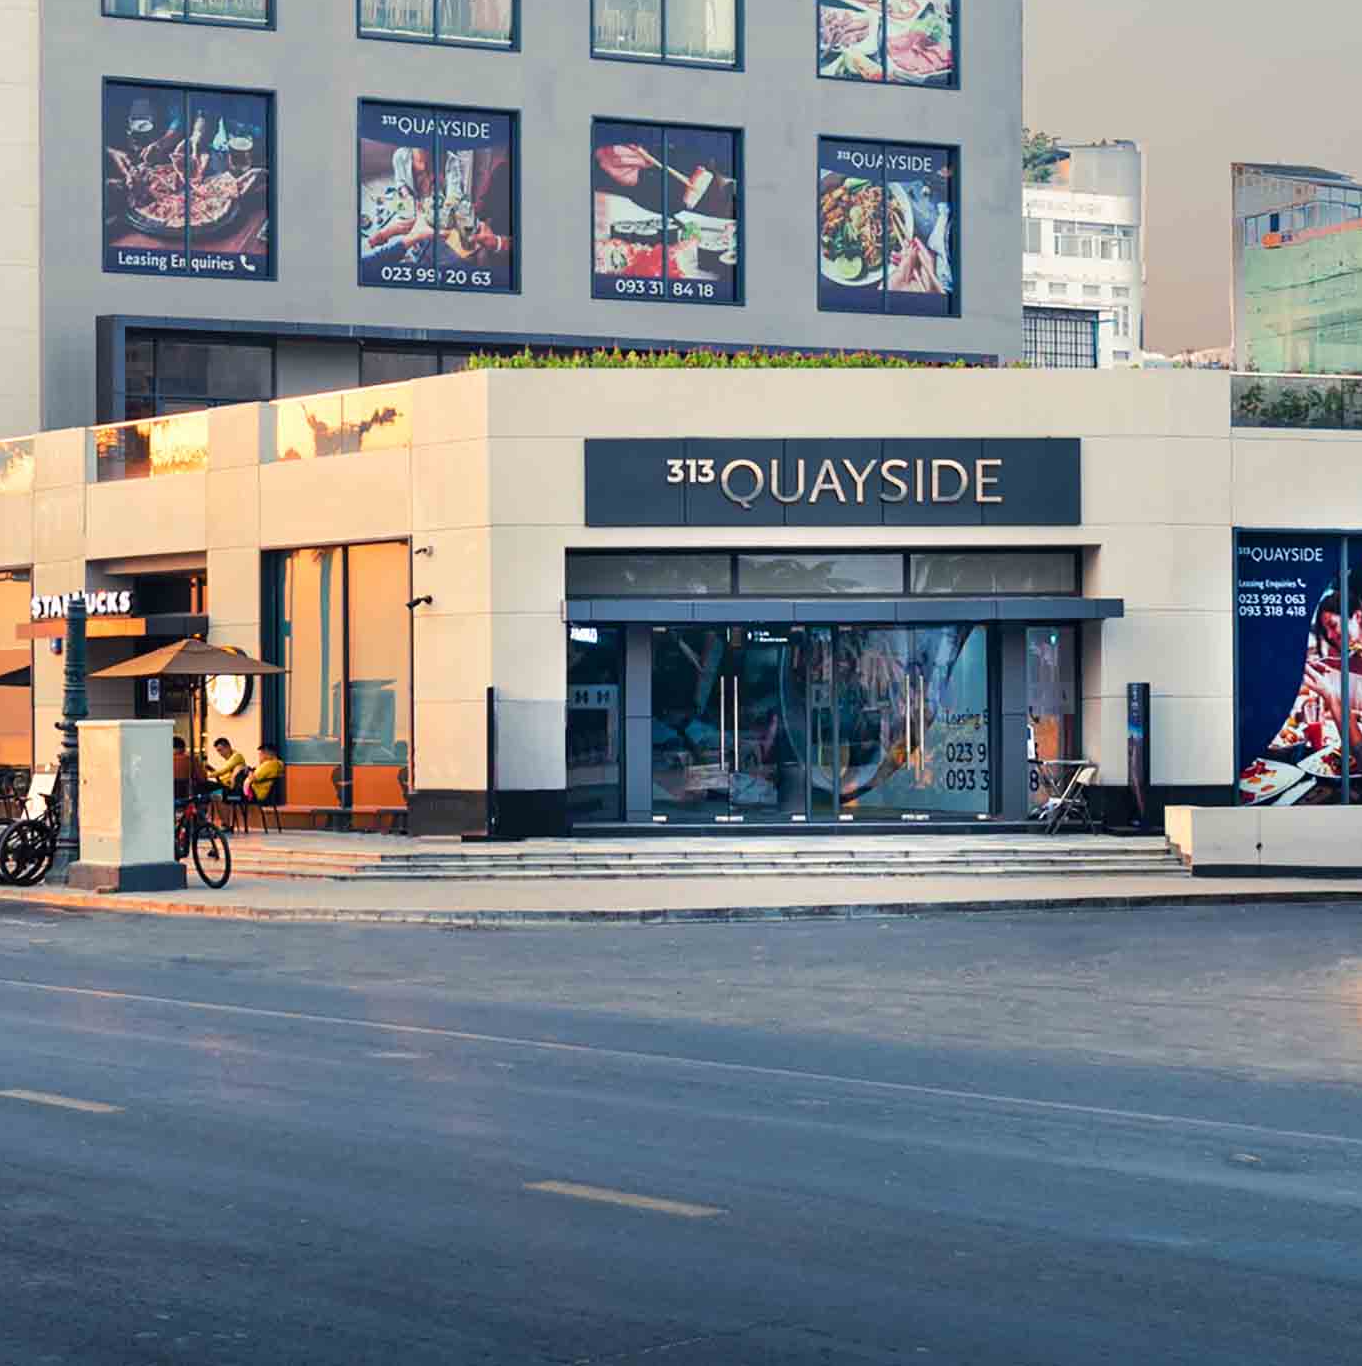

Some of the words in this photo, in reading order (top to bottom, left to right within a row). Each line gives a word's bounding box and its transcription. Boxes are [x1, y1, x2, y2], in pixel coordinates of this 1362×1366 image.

[118, 251, 167, 271] Leasing
[171, 254, 235, 272] Enquiries
[381, 266, 412, 282] 023
[445, 270, 467, 284] 20
[471, 271, 492, 286] 63
[615, 279, 645, 294] 093
[648, 281, 663, 295] 31
[673, 282, 694, 296] 84
[697, 284, 714, 298] 18
[1238, 593, 1260, 605] 023
[1261, 593, 1283, 605] 992
[1284, 593, 1306, 605] 063
[1239, 605, 1262, 618] 093
[1263, 605, 1284, 618] 318
[1286, 605, 1306, 618] 418
[946, 742, 974, 763] 023
[946, 769, 976, 791] 093
